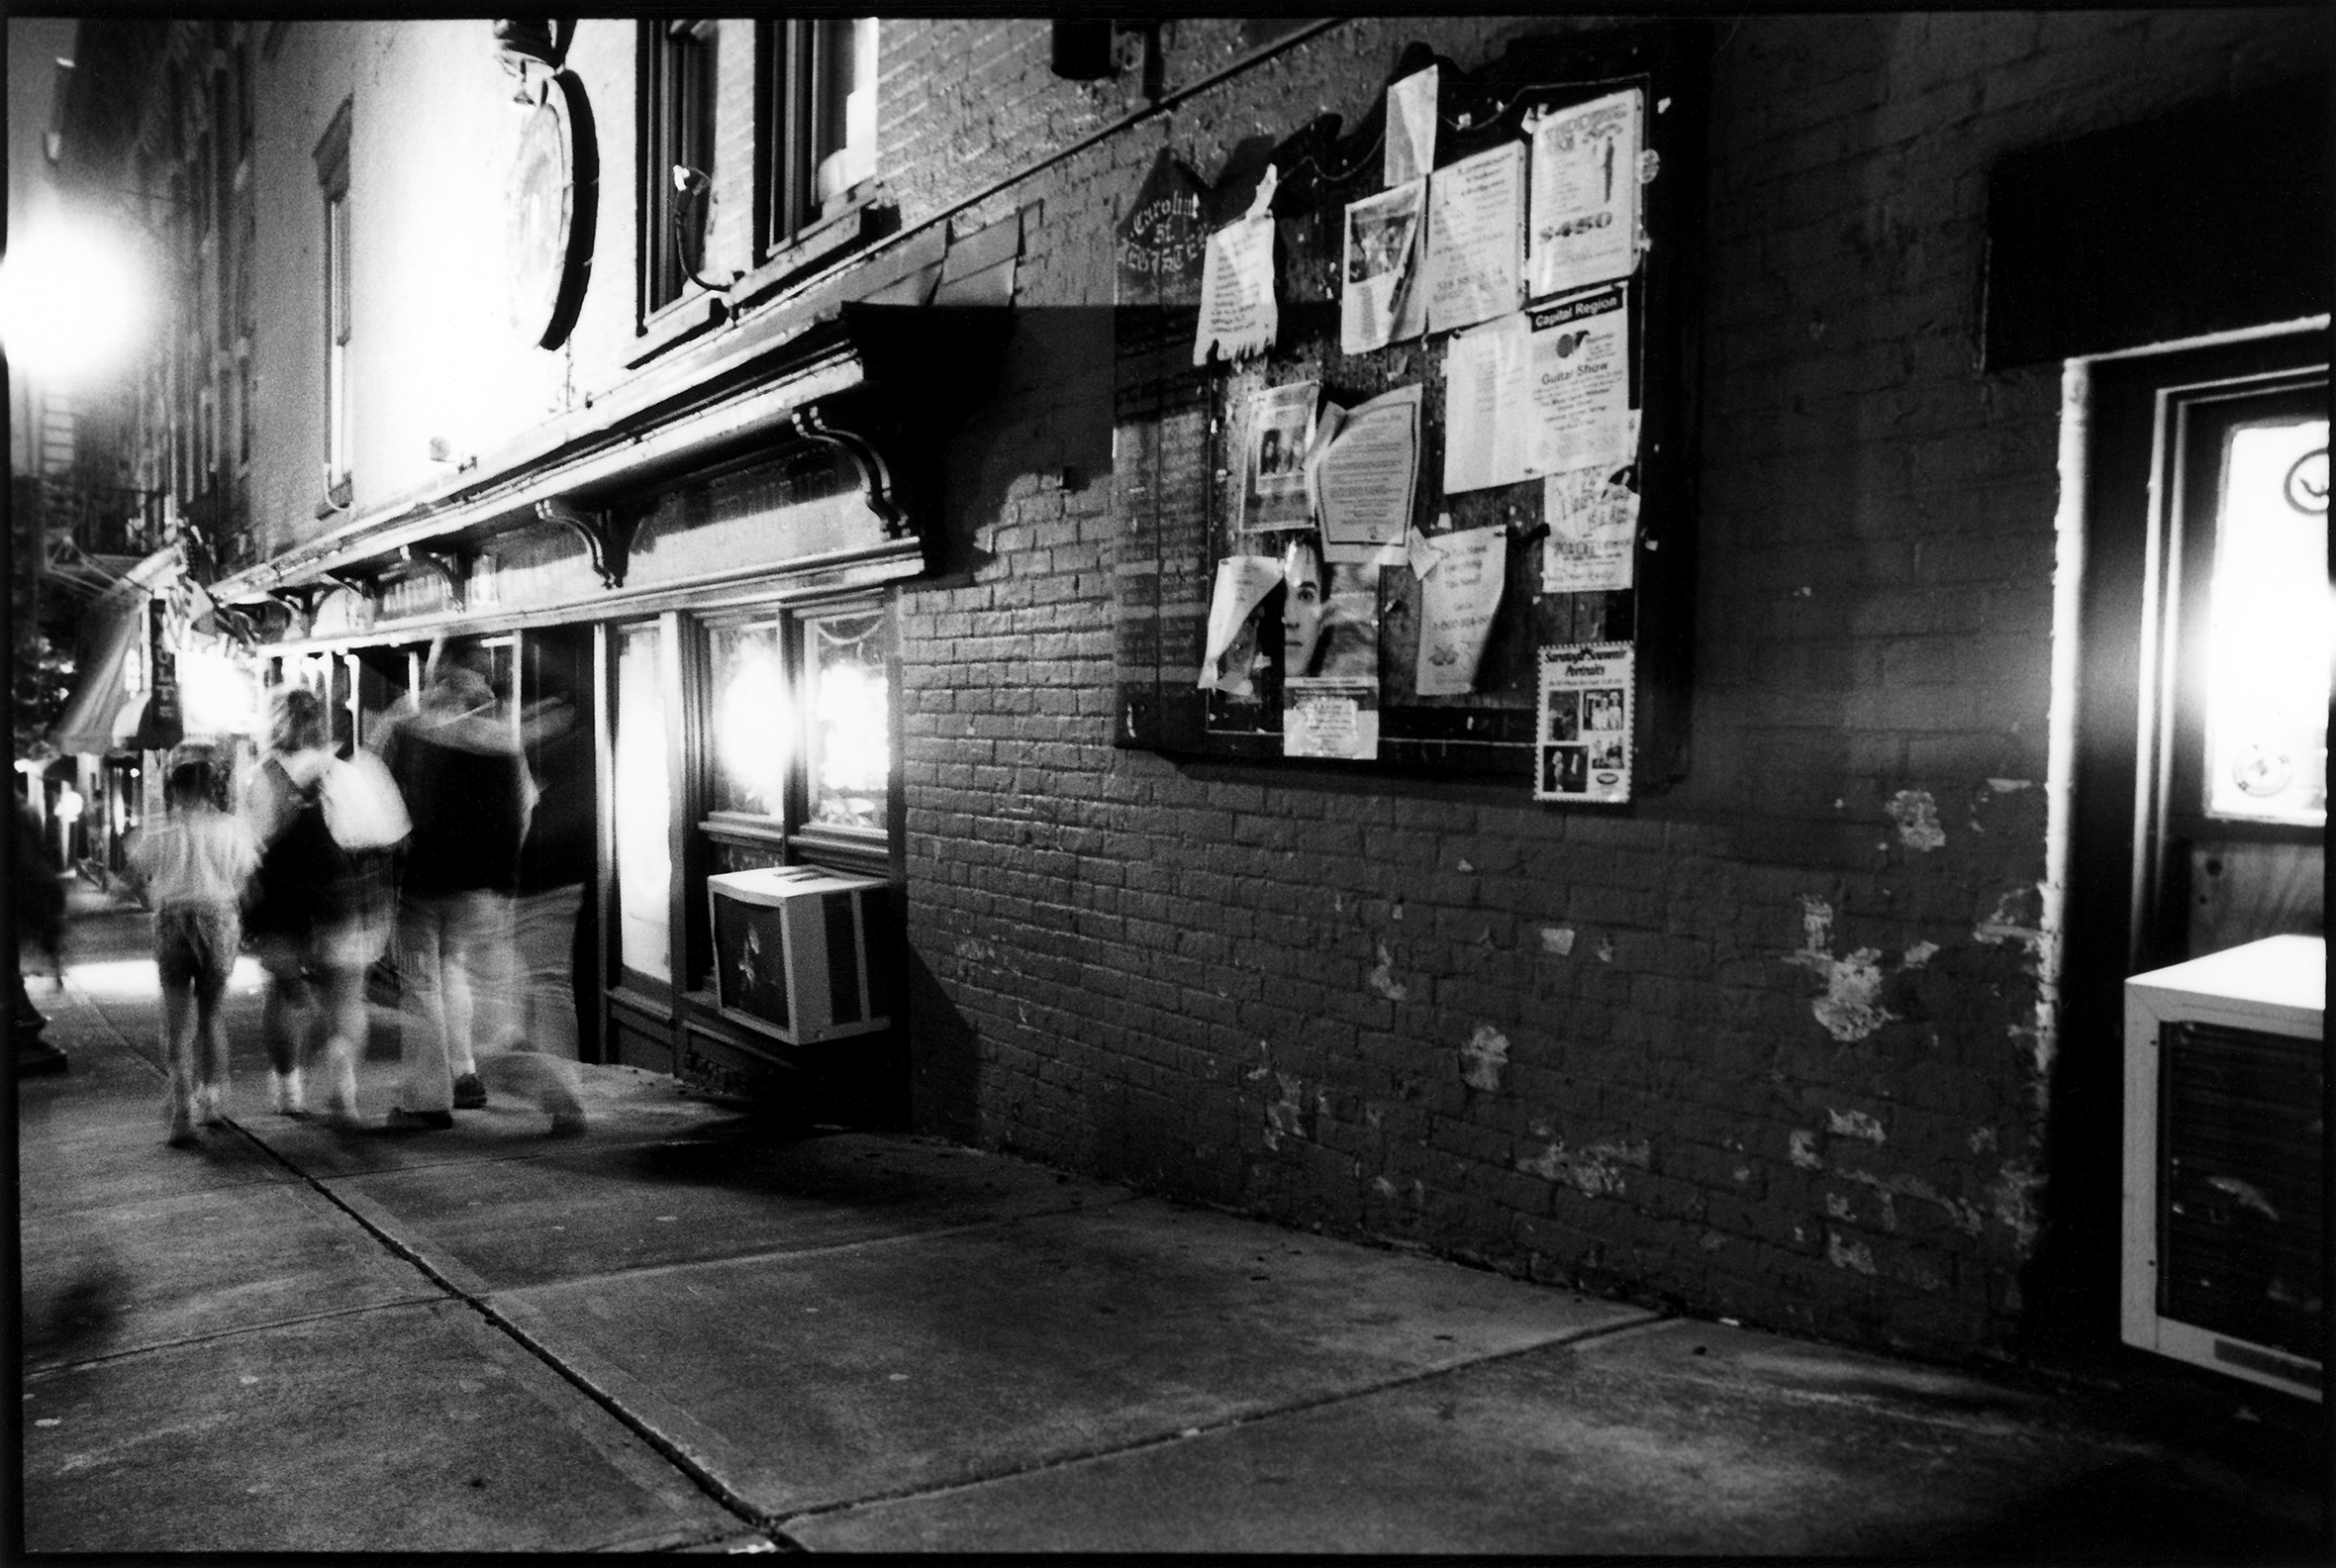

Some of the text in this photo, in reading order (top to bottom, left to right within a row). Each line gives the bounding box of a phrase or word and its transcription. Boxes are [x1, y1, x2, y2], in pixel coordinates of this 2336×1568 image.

[1133, 189, 1200, 236] Carolin
[1535, 296, 1617, 327] Capital Region
[1541, 361, 1608, 385] Guitar Show
